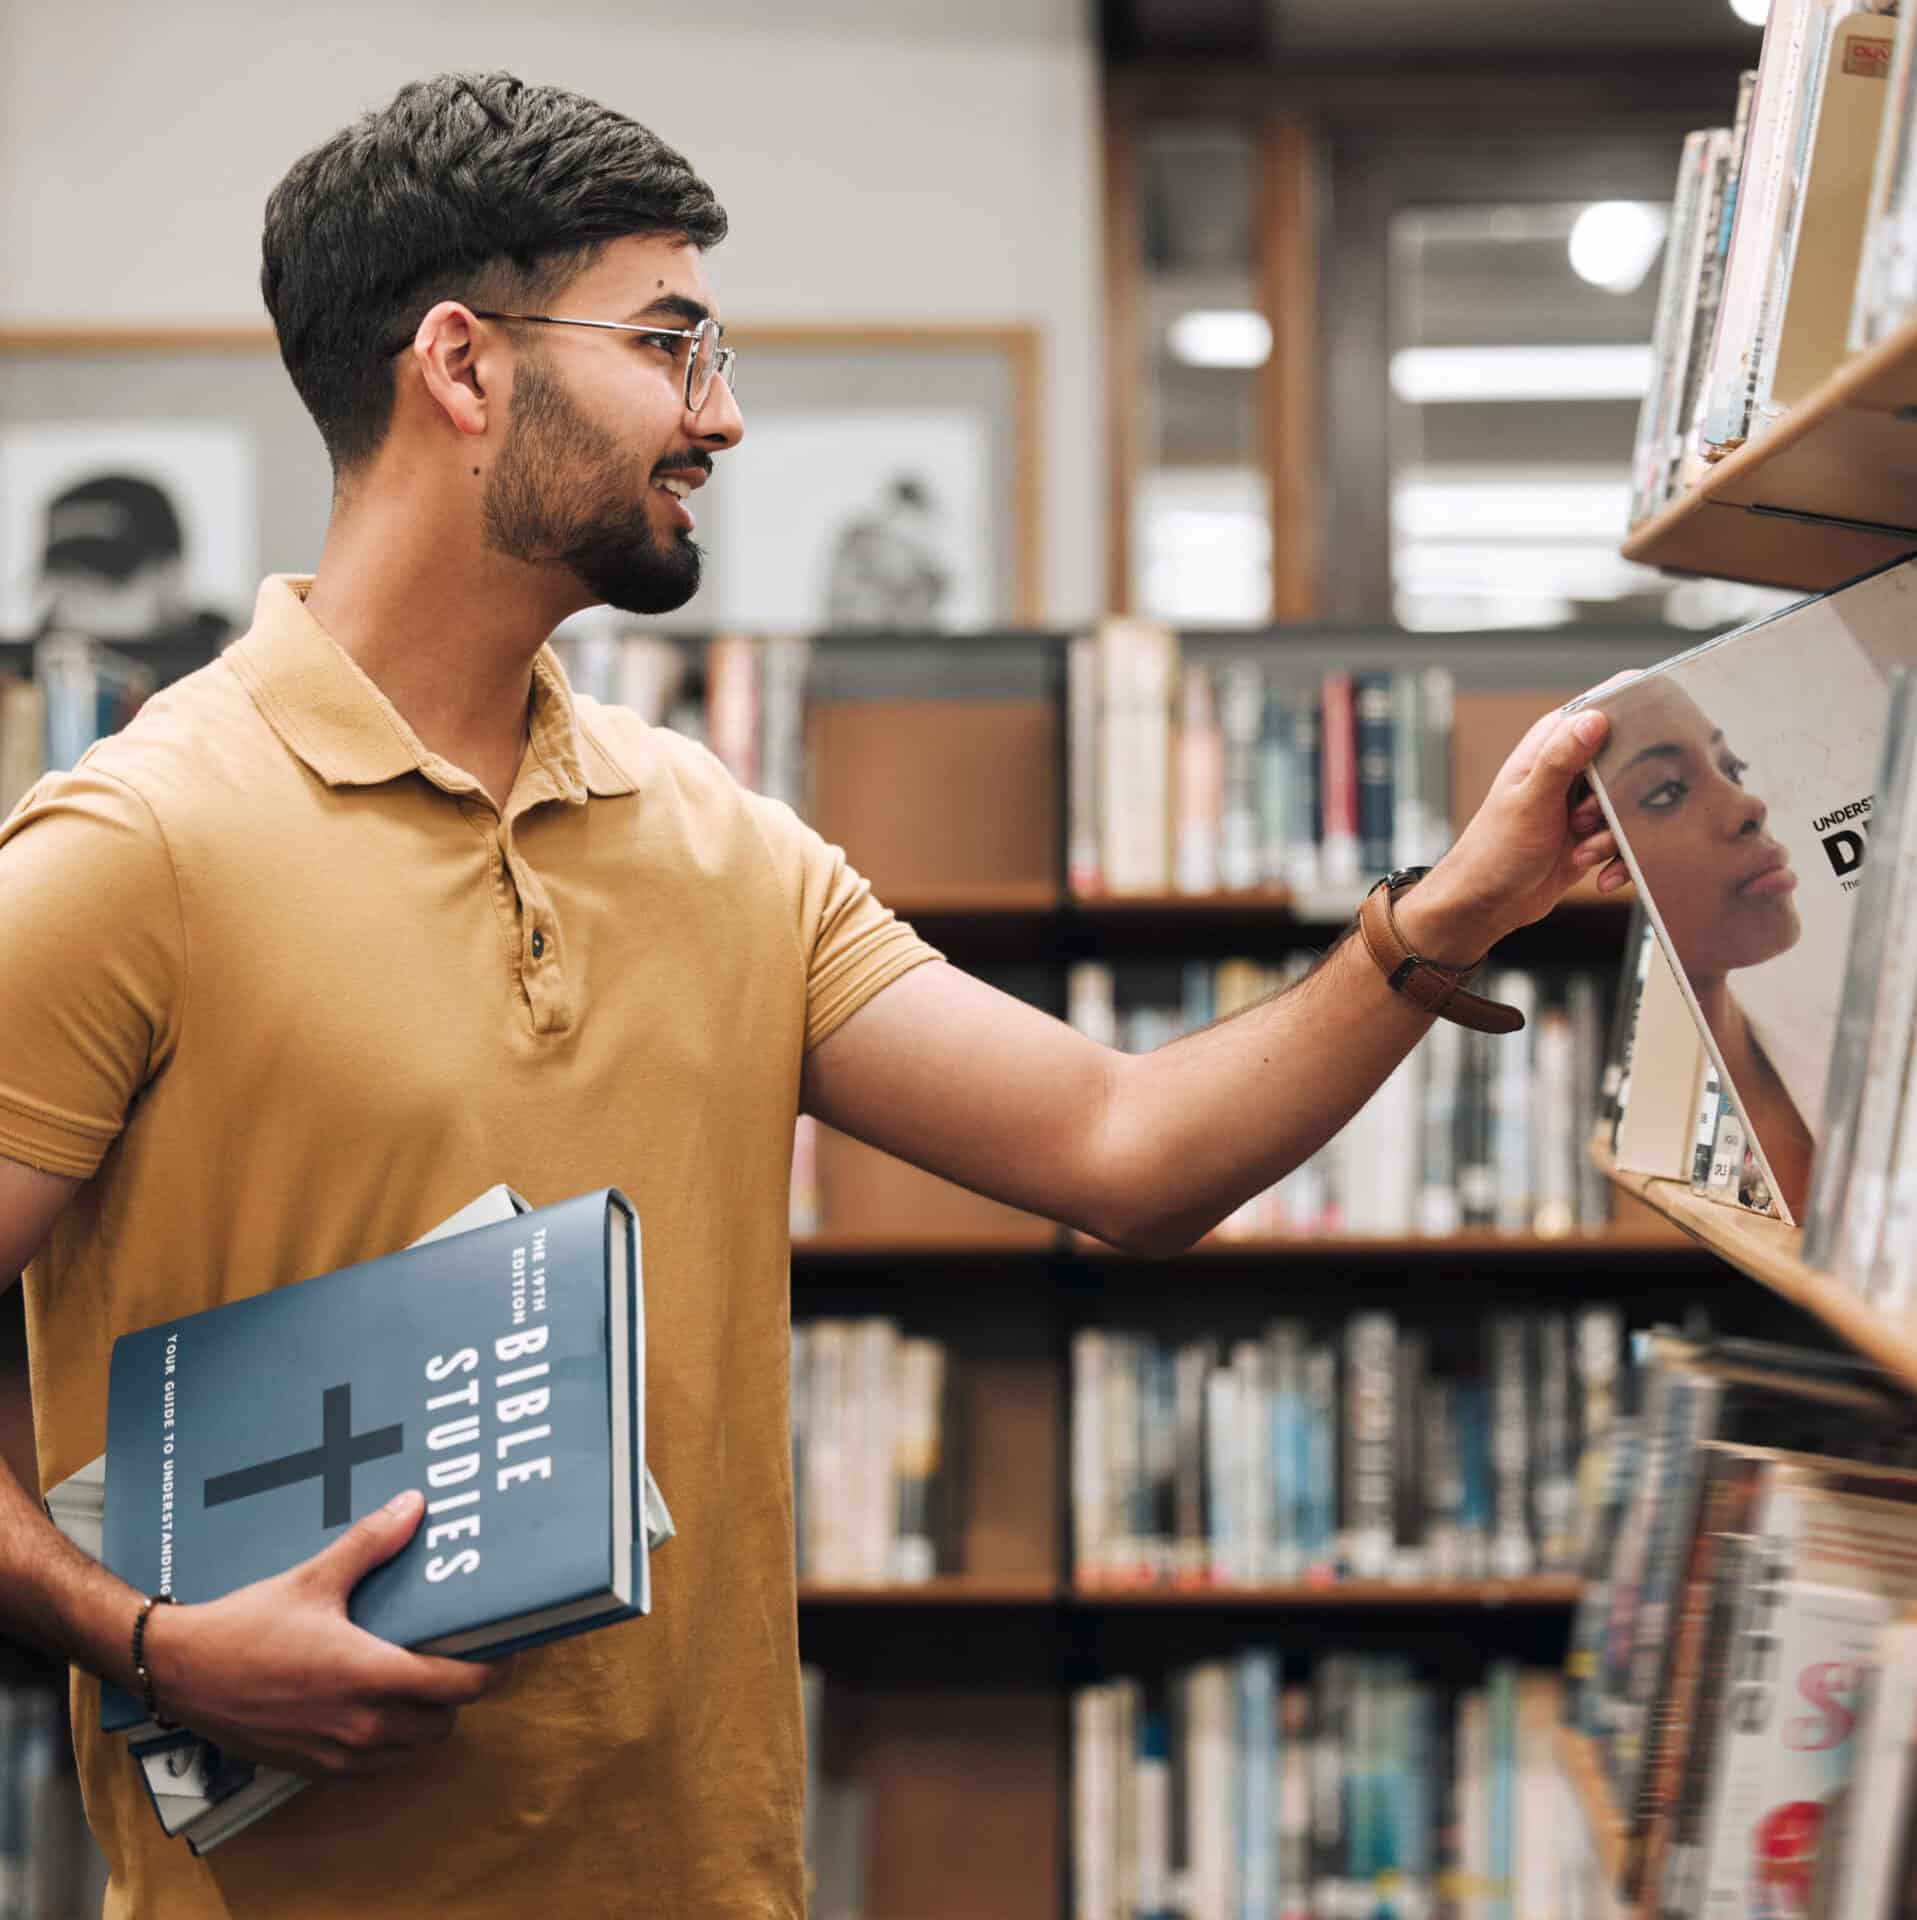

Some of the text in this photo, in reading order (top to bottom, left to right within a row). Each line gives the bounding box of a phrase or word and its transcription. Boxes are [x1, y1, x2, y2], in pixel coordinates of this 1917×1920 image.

[1821, 820, 1870, 877] D
[511, 1247, 525, 1324] EDITION
[532, 1227, 546, 1312] THE 19TH
[160, 1333, 178, 1595] YOUR GUIDE TO UNDERSTANDING
[425, 1347, 480, 1583] STUDIES
[495, 1325, 551, 1491] BIBLE
